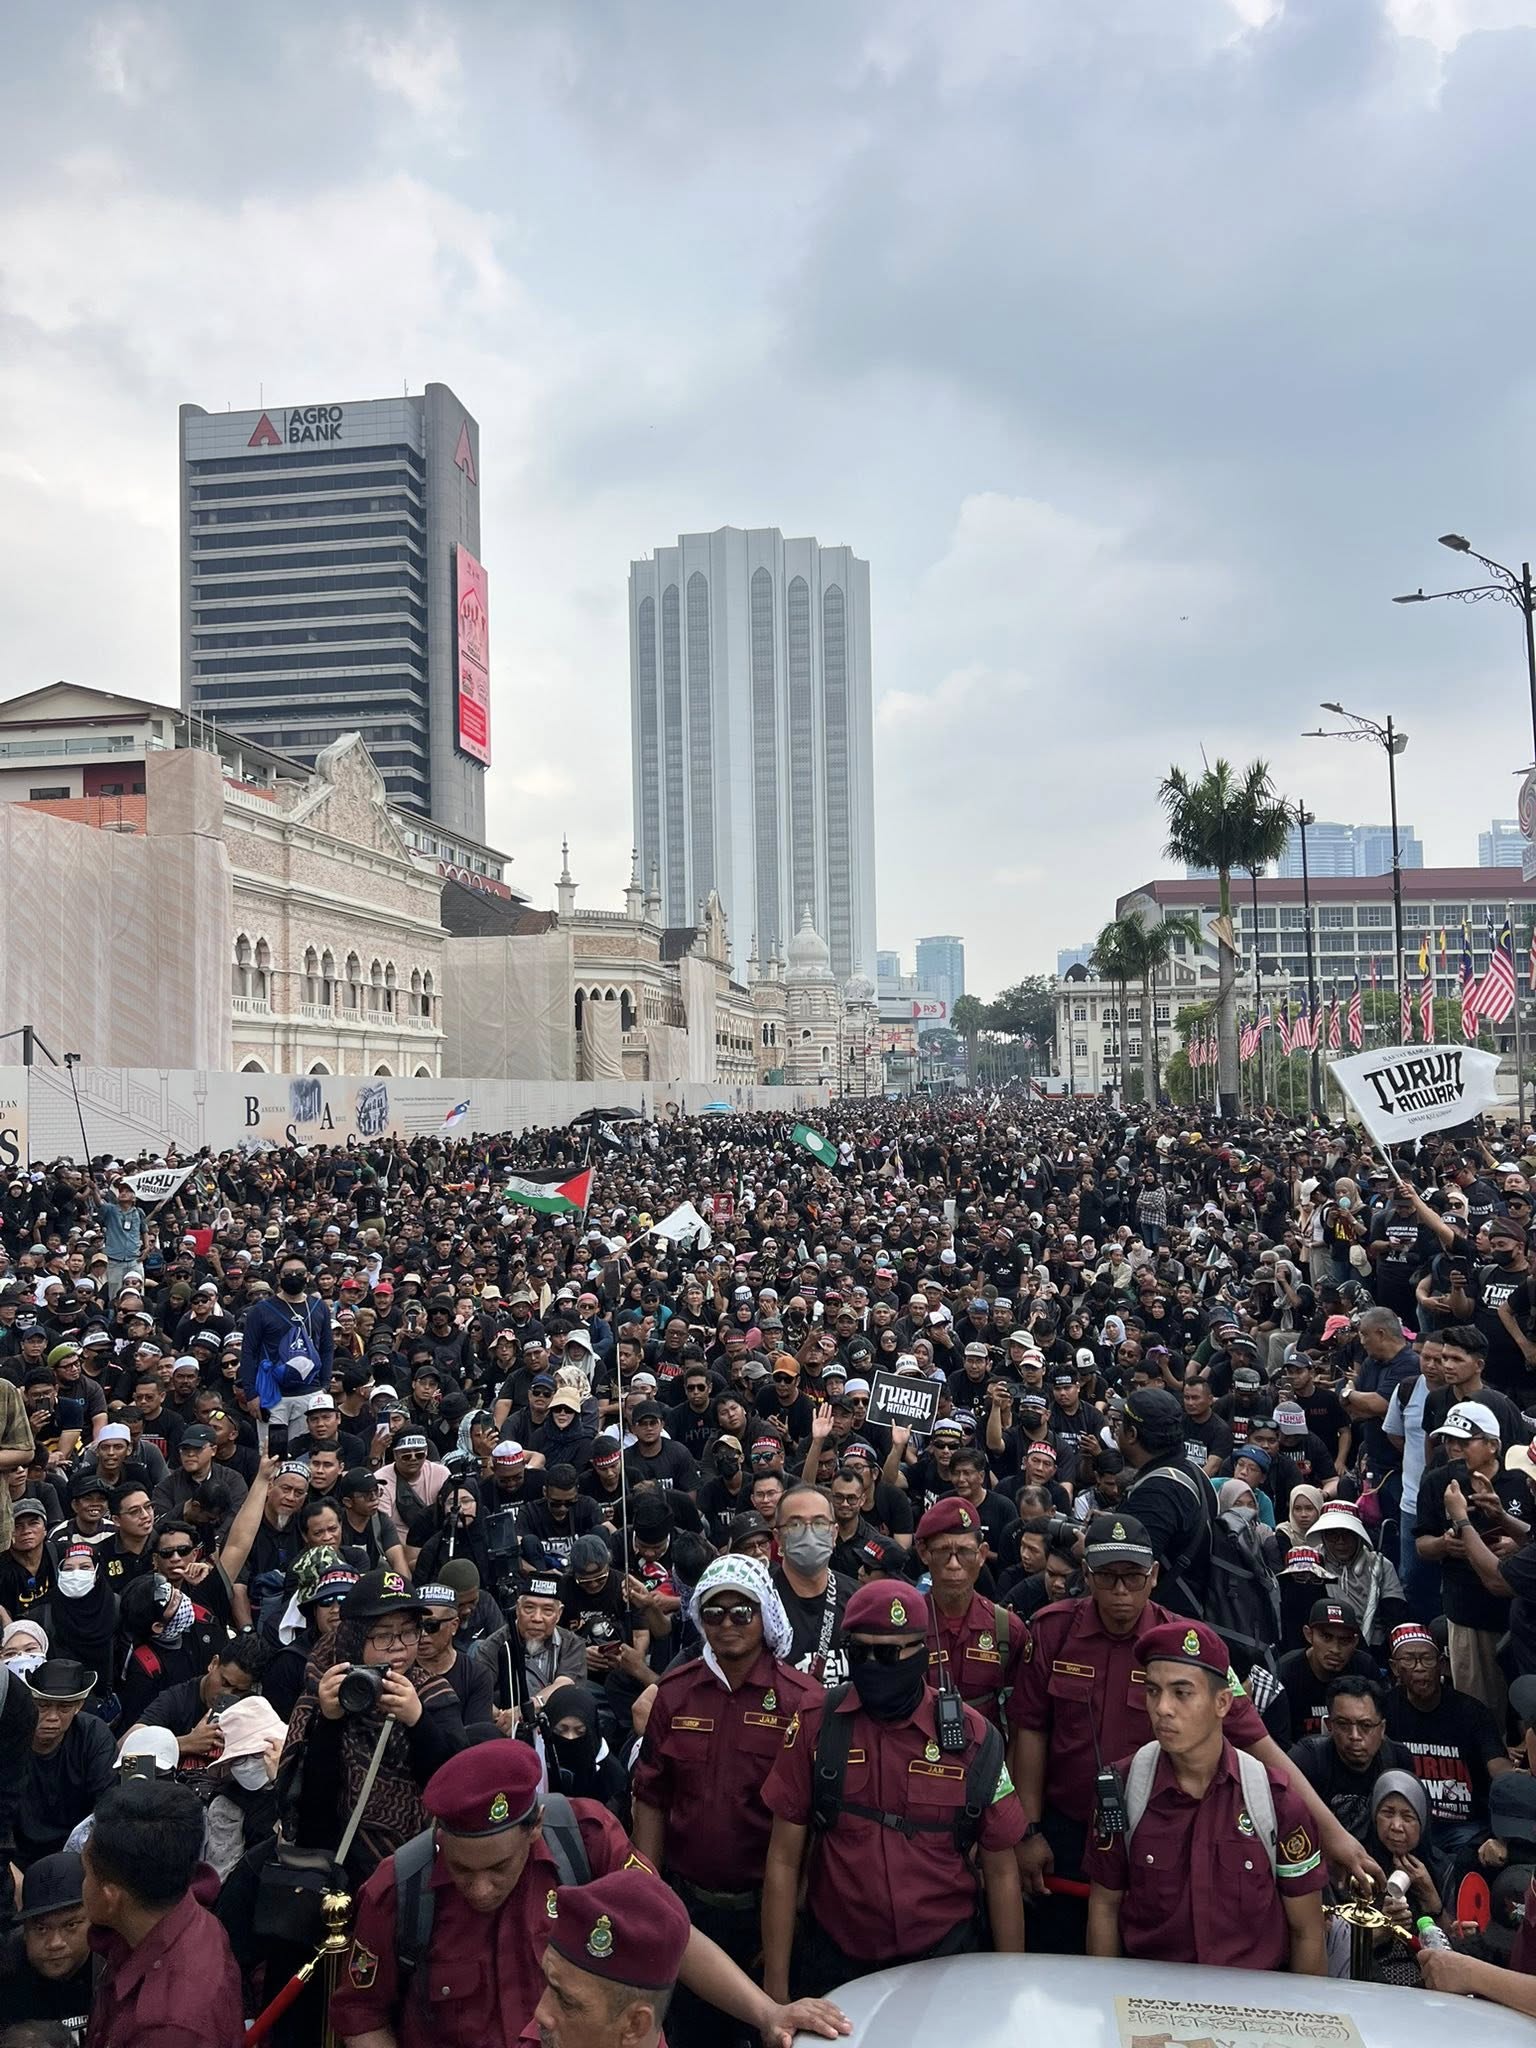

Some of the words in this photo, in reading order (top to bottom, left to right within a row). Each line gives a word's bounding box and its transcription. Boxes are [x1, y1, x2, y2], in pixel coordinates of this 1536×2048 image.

[290, 406, 343, 426] AGRO
[289, 423, 342, 443] BANK
[1362, 1051, 1465, 1115] TURUN
[1395, 1083, 1456, 1112] ANWAR
[876, 1383, 932, 1420] TURUN
[886, 1402, 923, 1419] ANWAR
[107, 1559, 124, 1576] 33
[418, 1585, 455, 1601] TURUN
[760, 1716, 778, 1726] JAM
[928, 1765, 945, 1775] JAM
[1128, 1997, 1180, 2007] ALAM
[1186, 2001, 1239, 2012] SHAH
[1244, 2006, 1340, 2021] KAWASAN
